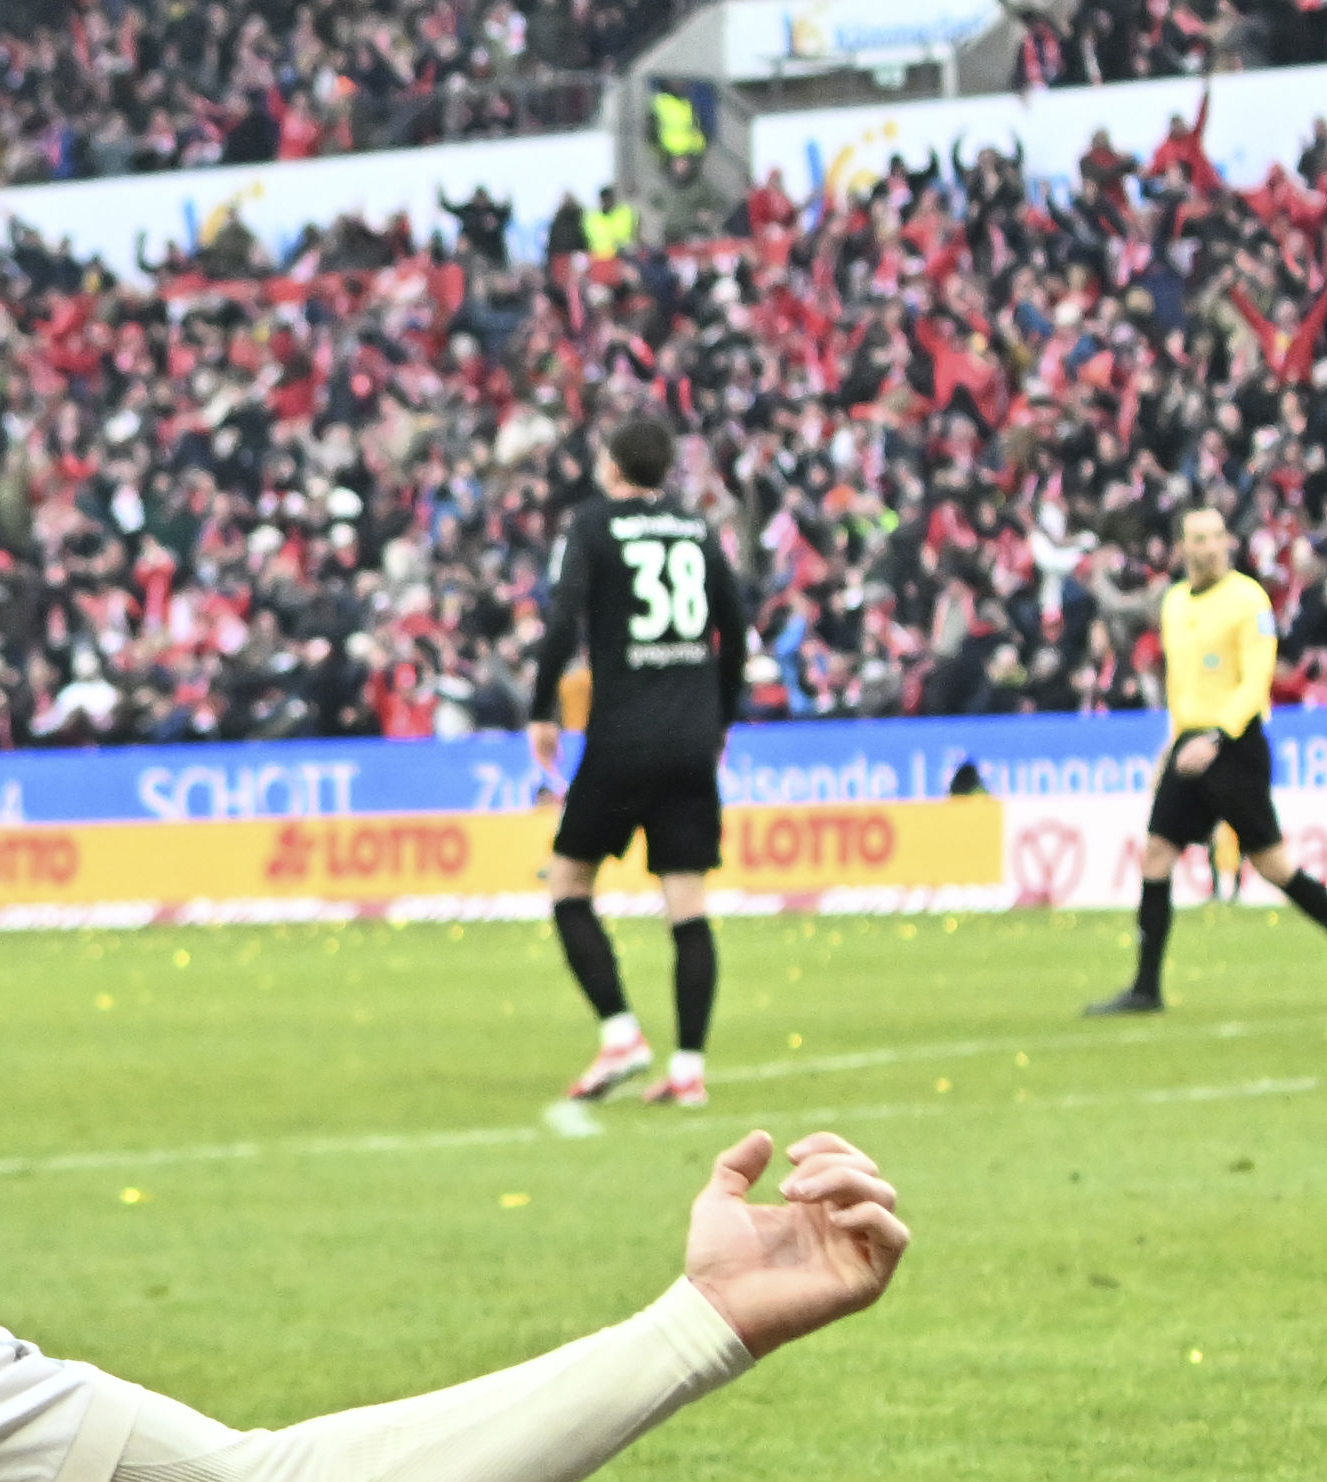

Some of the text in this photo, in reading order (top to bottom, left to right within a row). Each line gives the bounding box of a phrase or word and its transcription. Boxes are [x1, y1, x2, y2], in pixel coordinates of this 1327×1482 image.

[622, 539, 707, 641] 38
[138, 763, 358, 821] SCHOTT
[327, 825, 469, 876] LOTTO
[740, 815, 894, 868] LOTTO
